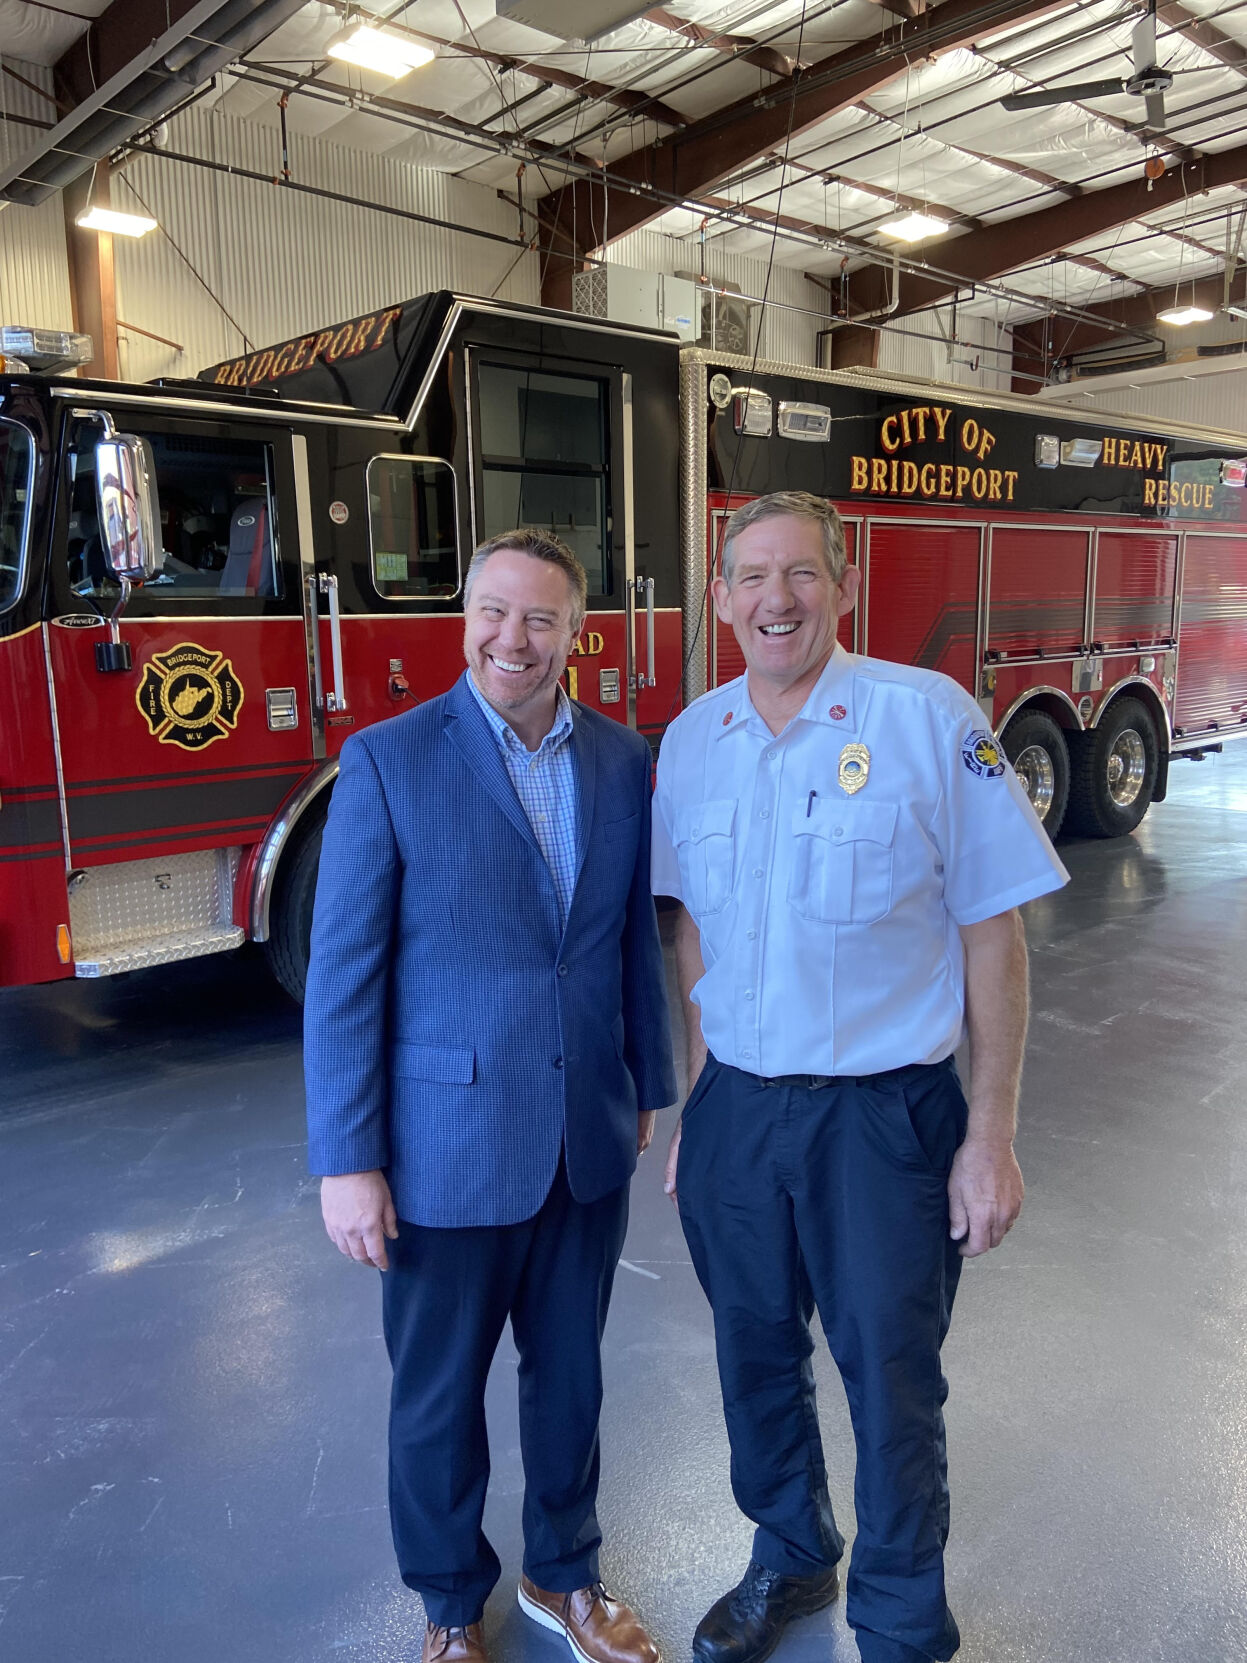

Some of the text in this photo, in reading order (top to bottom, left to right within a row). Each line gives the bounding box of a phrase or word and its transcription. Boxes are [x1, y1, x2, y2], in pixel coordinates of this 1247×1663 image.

[214, 307, 403, 387] BRIDGEPORT
[881, 406, 996, 461] CITY OF
[1102, 437, 1168, 472] HEAVY
[850, 455, 1018, 502] BRIDGEPORT
[1143, 478, 1215, 509] RESCUE
[167, 653, 211, 667] BRIDGEPORT
